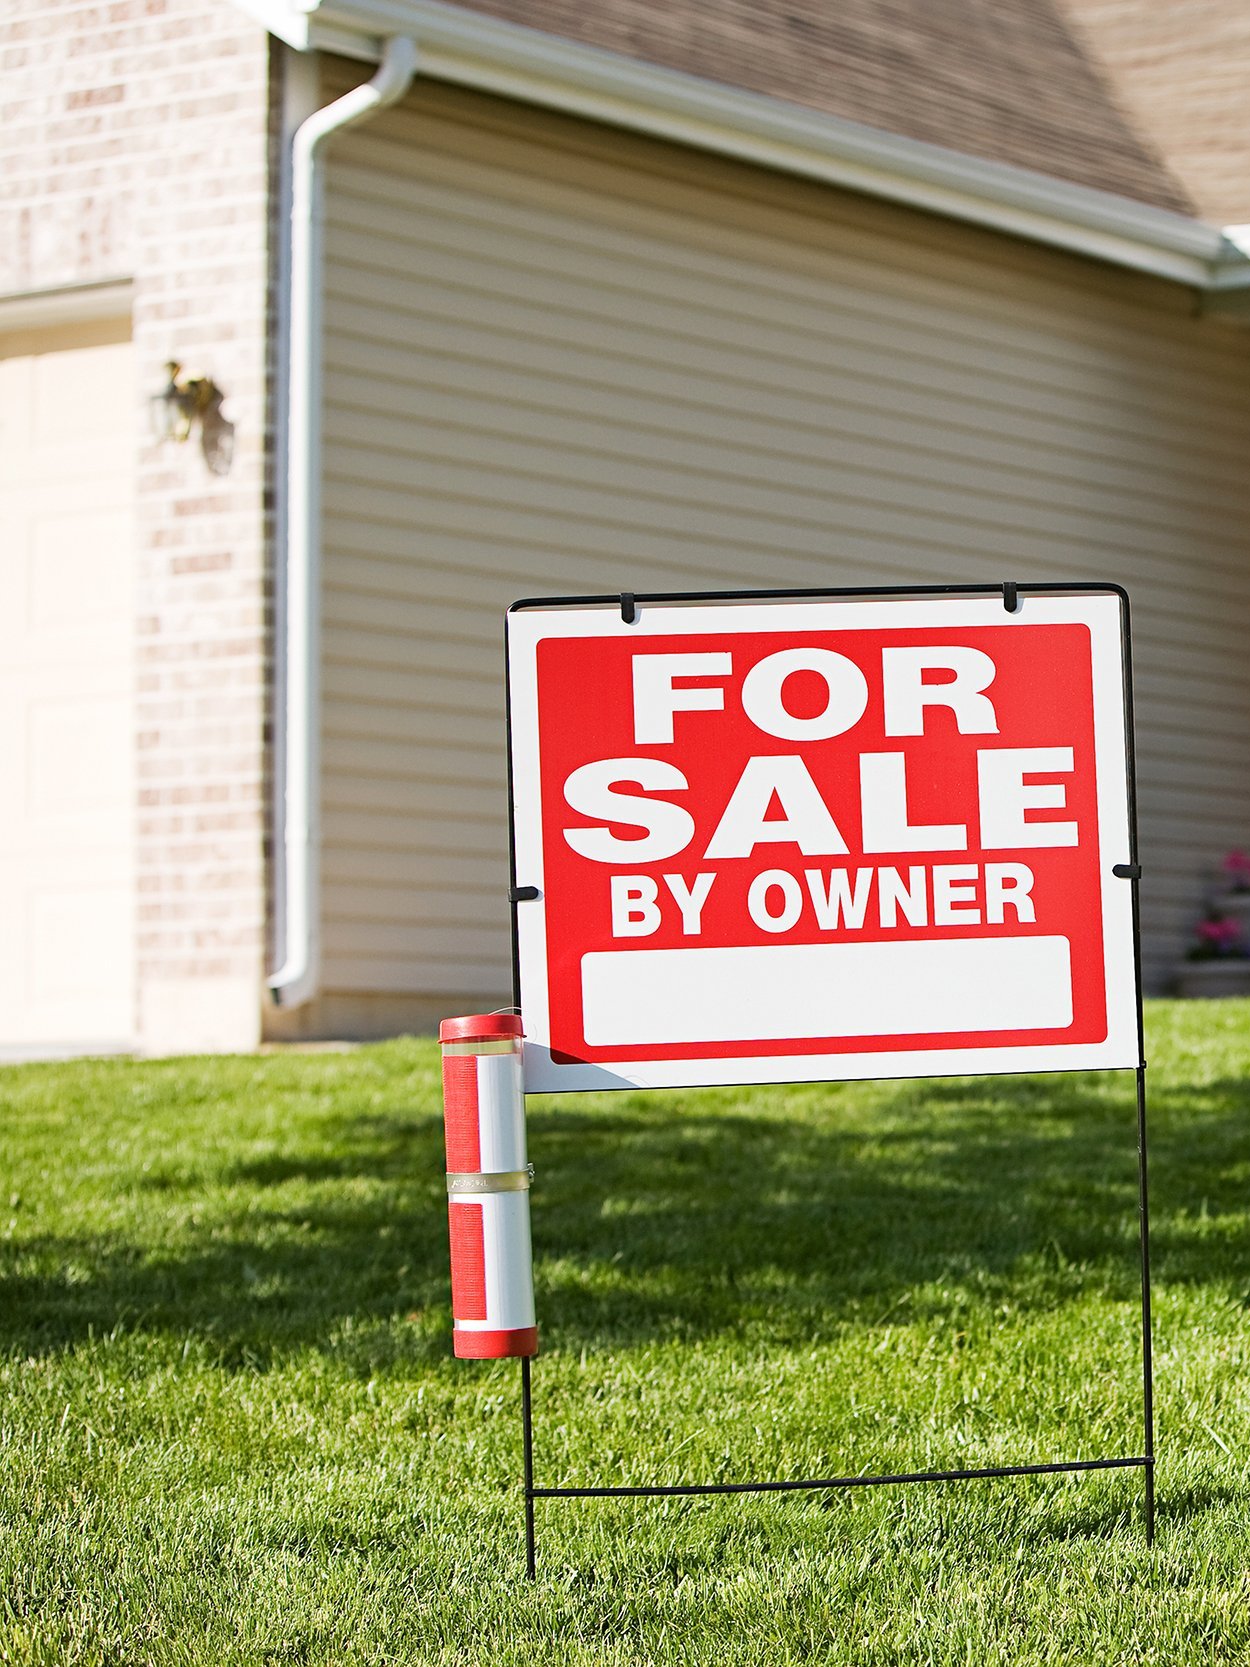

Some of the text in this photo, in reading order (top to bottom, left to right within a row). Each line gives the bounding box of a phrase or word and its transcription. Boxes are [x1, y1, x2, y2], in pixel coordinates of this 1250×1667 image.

[632, 646, 1000, 744] FOR
[563, 747, 1078, 863] SALE
[611, 863, 1036, 937] BY OWNER
